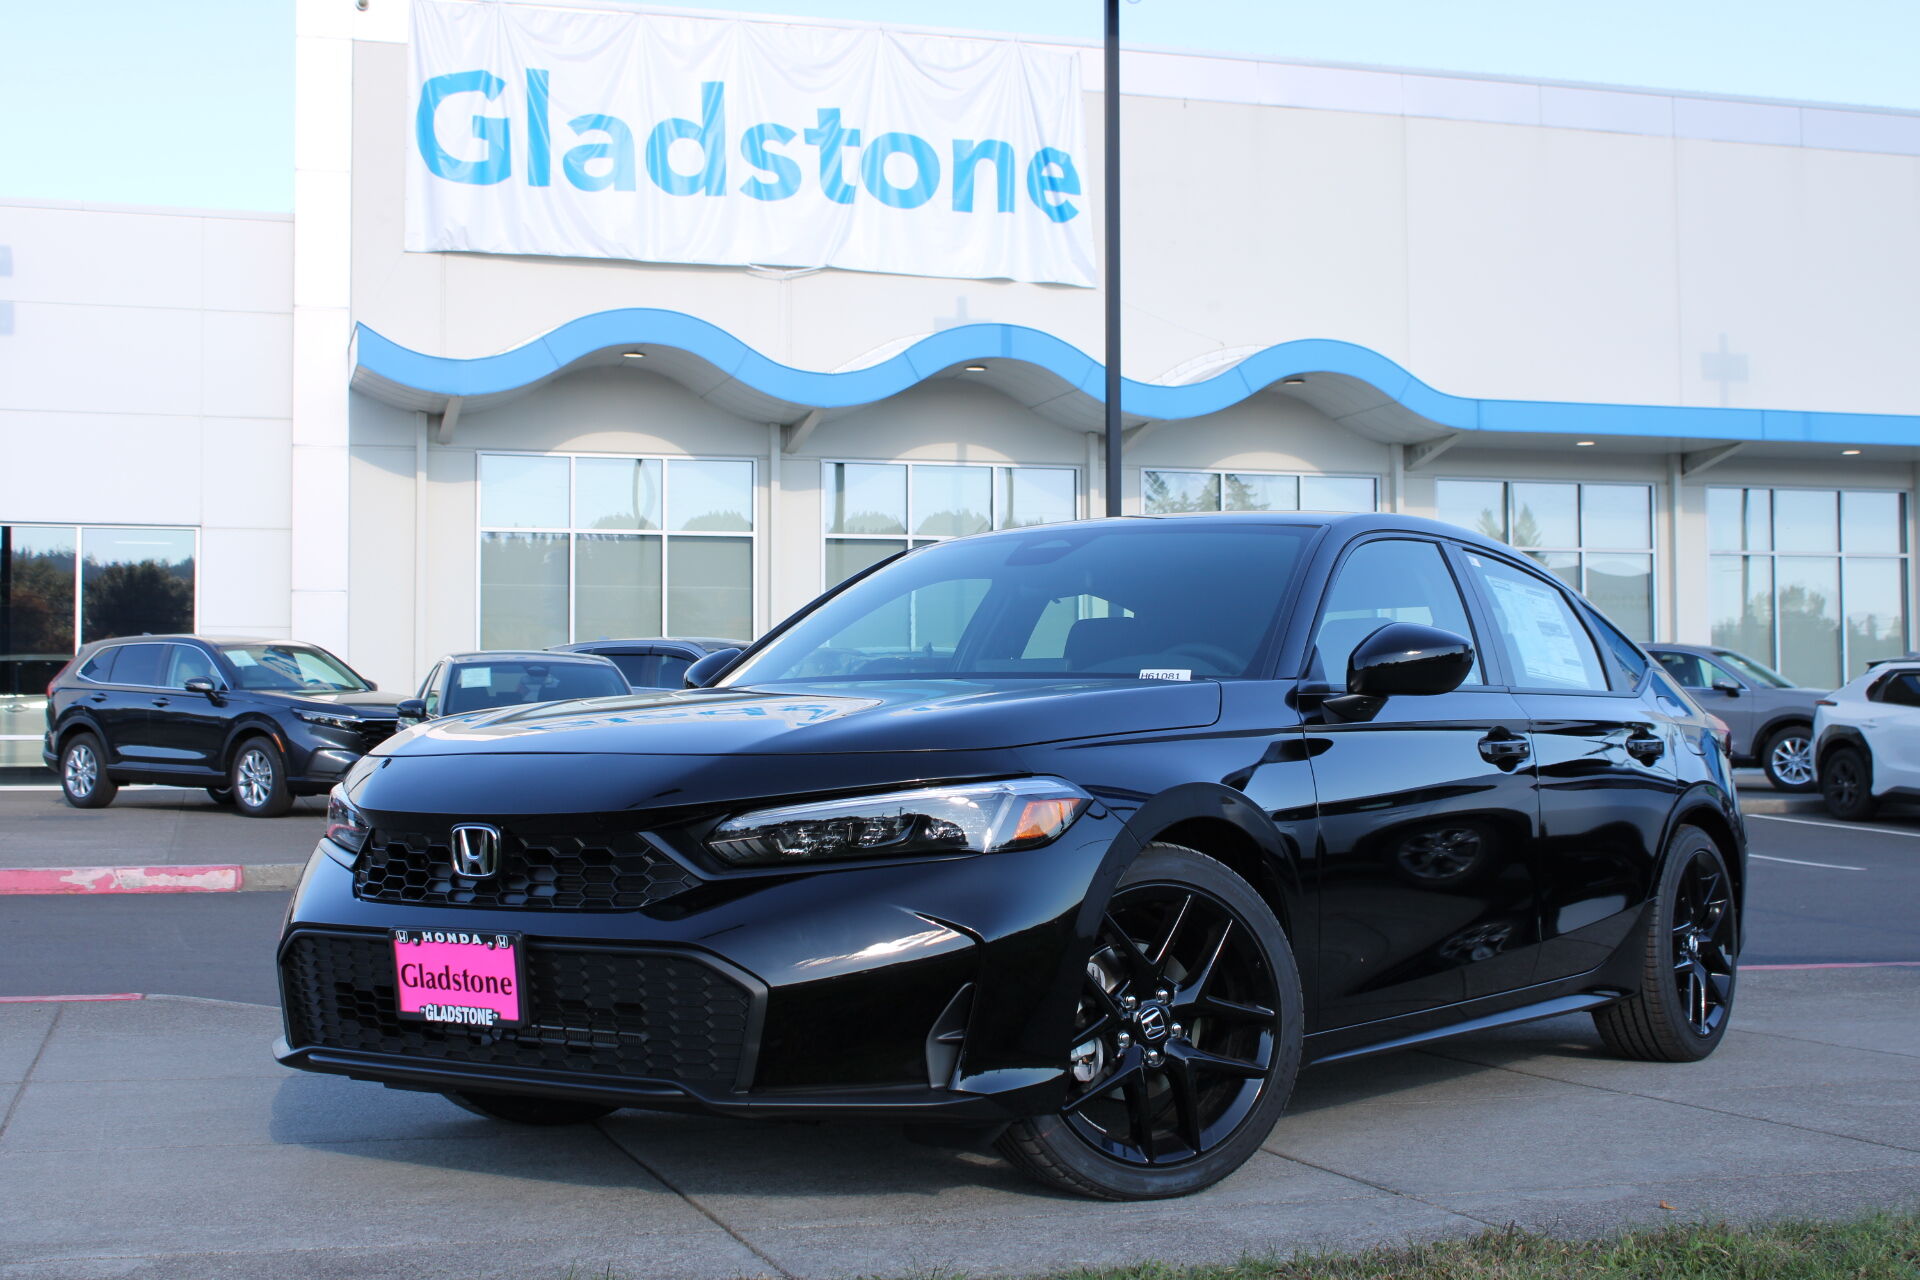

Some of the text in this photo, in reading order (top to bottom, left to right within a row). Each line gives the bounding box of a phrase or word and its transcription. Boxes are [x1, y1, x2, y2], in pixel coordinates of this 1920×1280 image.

[415, 67, 1083, 224] Gladstone
[1141, 672, 1180, 680] H61081
[421, 931, 483, 945] HONDA
[401, 963, 513, 996] Gladstone
[425, 1004, 494, 1026] GLADSTONE
